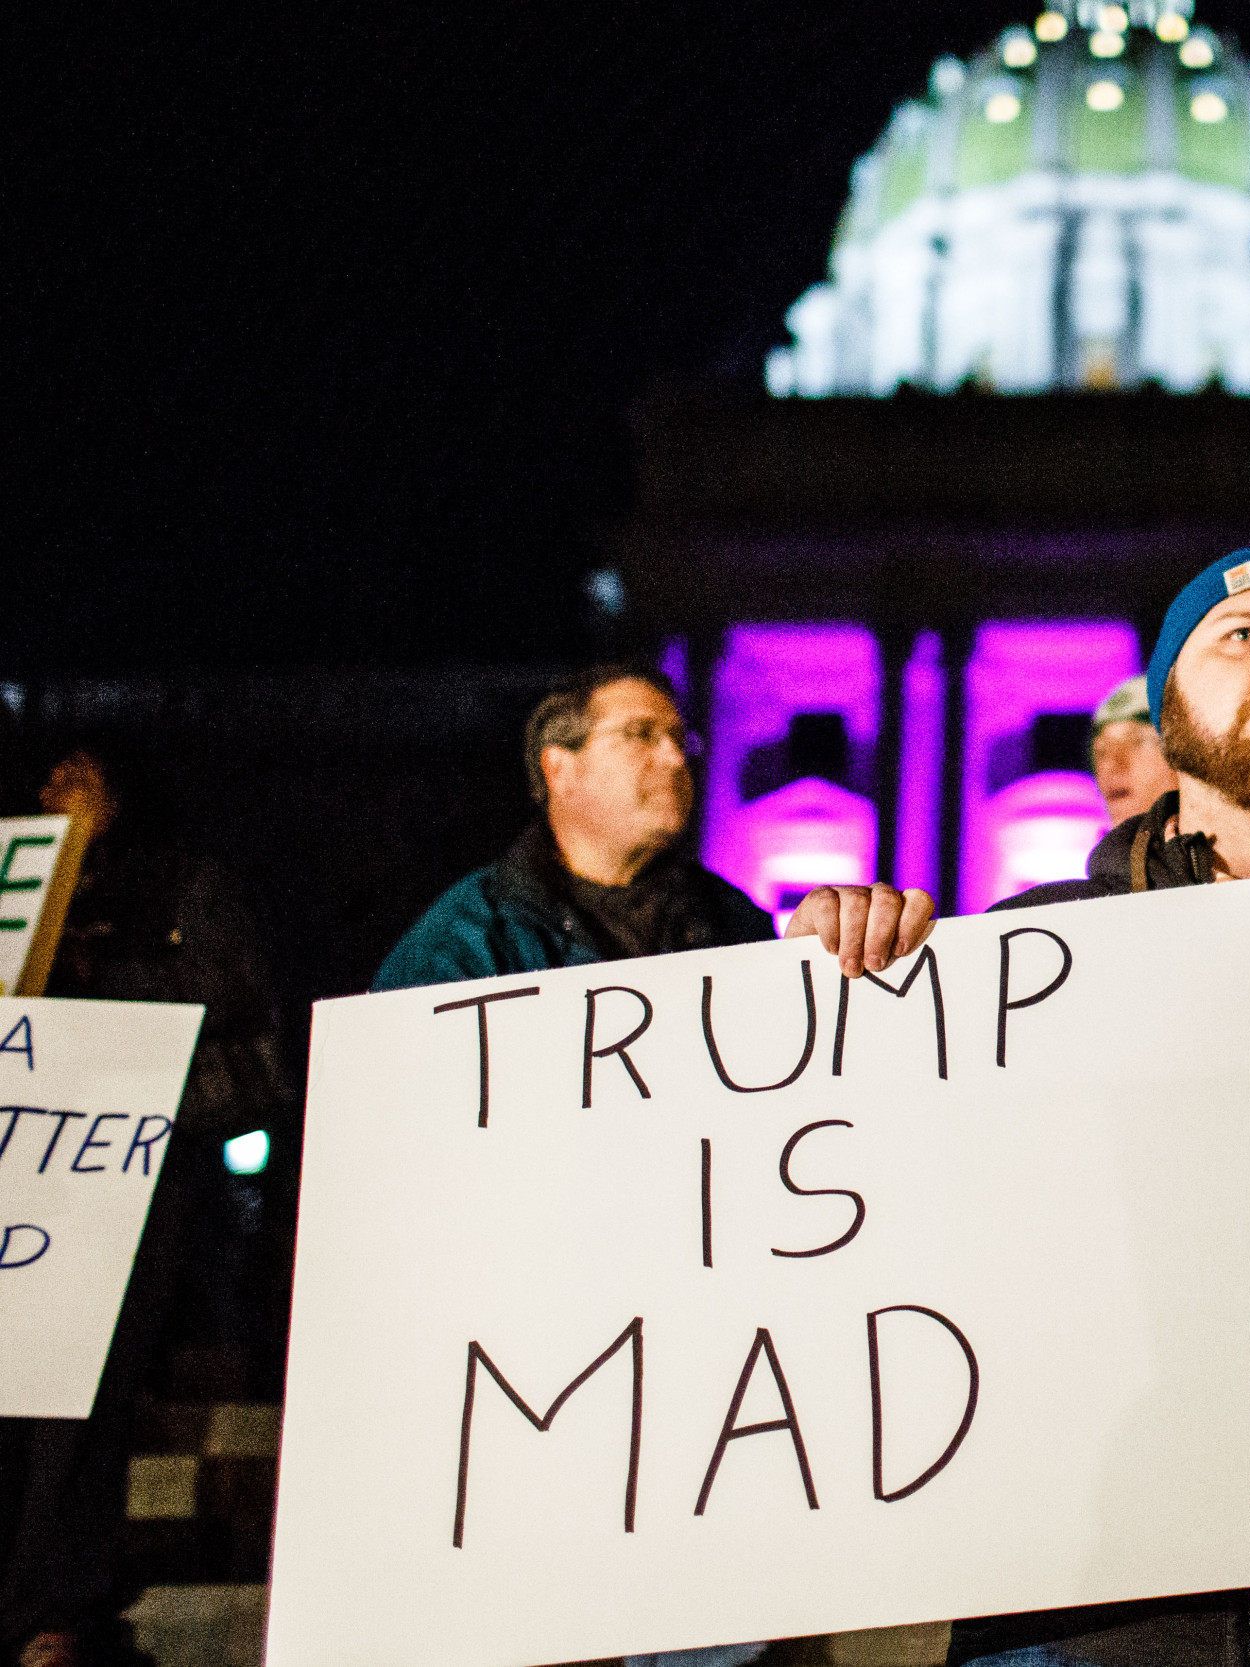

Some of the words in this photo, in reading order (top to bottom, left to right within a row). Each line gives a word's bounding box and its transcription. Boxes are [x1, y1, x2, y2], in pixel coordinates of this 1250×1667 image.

[432, 927, 1074, 1129] TRUMP
[700, 1119, 867, 1269] IS
[452, 1304, 980, 1549] MAD
